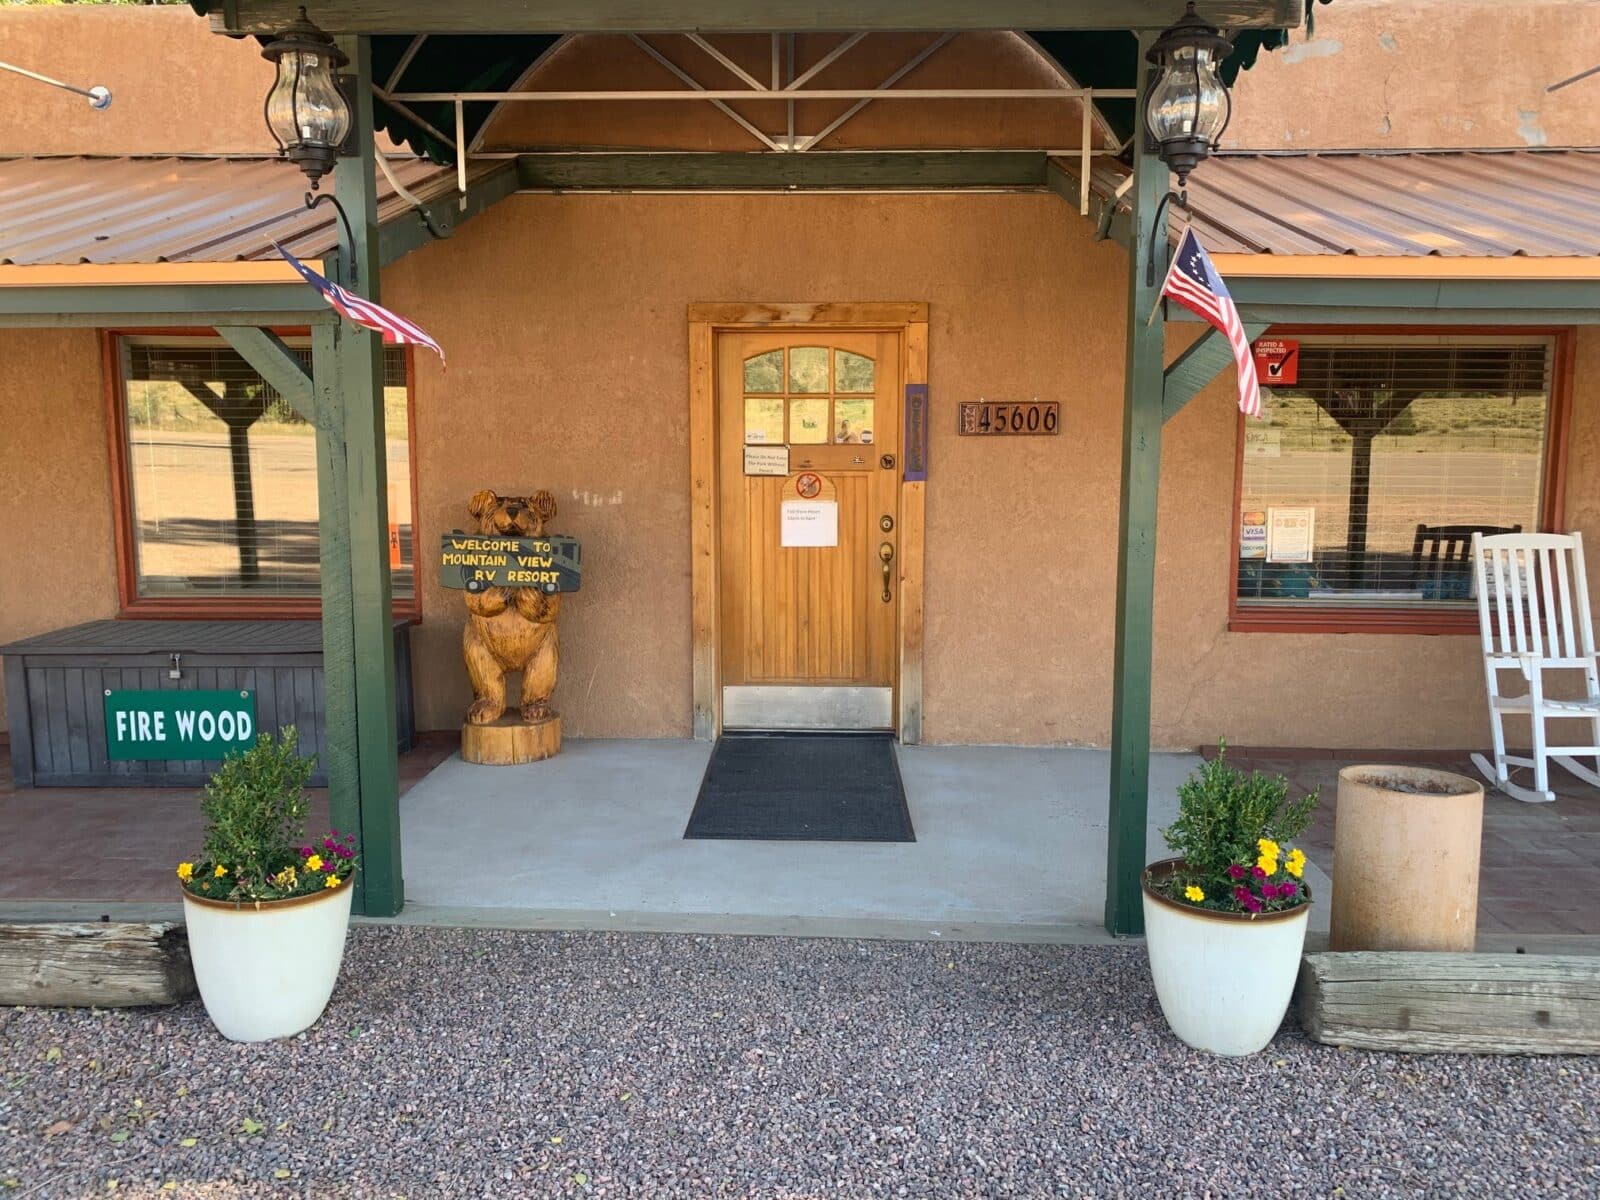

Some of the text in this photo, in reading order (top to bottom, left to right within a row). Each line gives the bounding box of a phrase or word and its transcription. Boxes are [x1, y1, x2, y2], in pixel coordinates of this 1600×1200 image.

[979, 406, 1056, 431] 45606
[451, 539, 551, 552] WELCOME TO
[442, 553, 553, 567] MOUNTAIN VIEW
[474, 570, 560, 583] RV RESORT
[116, 710, 252, 742] FIRE WOOD
